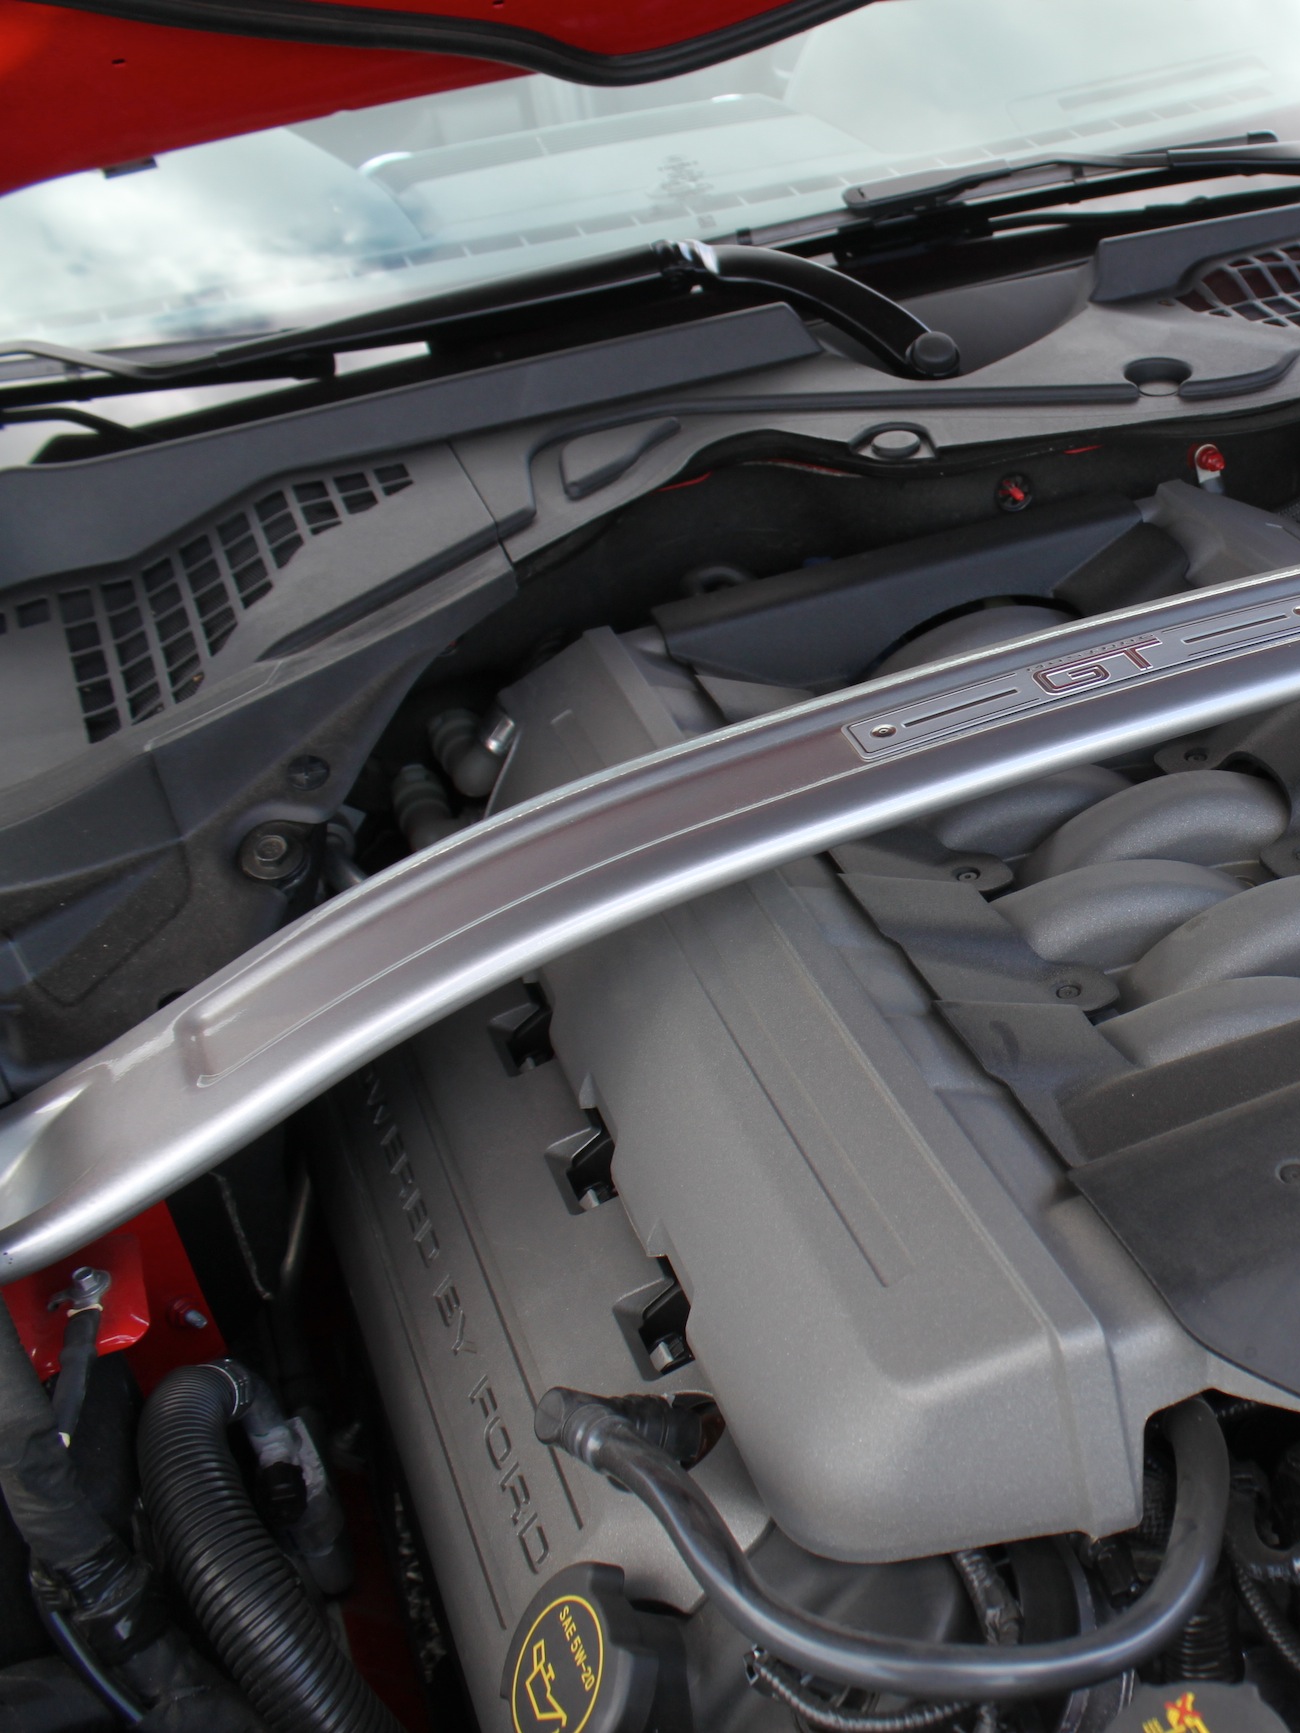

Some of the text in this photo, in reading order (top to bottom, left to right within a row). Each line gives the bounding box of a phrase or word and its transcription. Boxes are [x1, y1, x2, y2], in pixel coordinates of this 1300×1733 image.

[1032, 637, 1162, 695] GT
[433, 1274, 477, 1356] BY
[468, 1374, 550, 1575] FORD
[559, 1604, 595, 1692] SAE 5W-20
